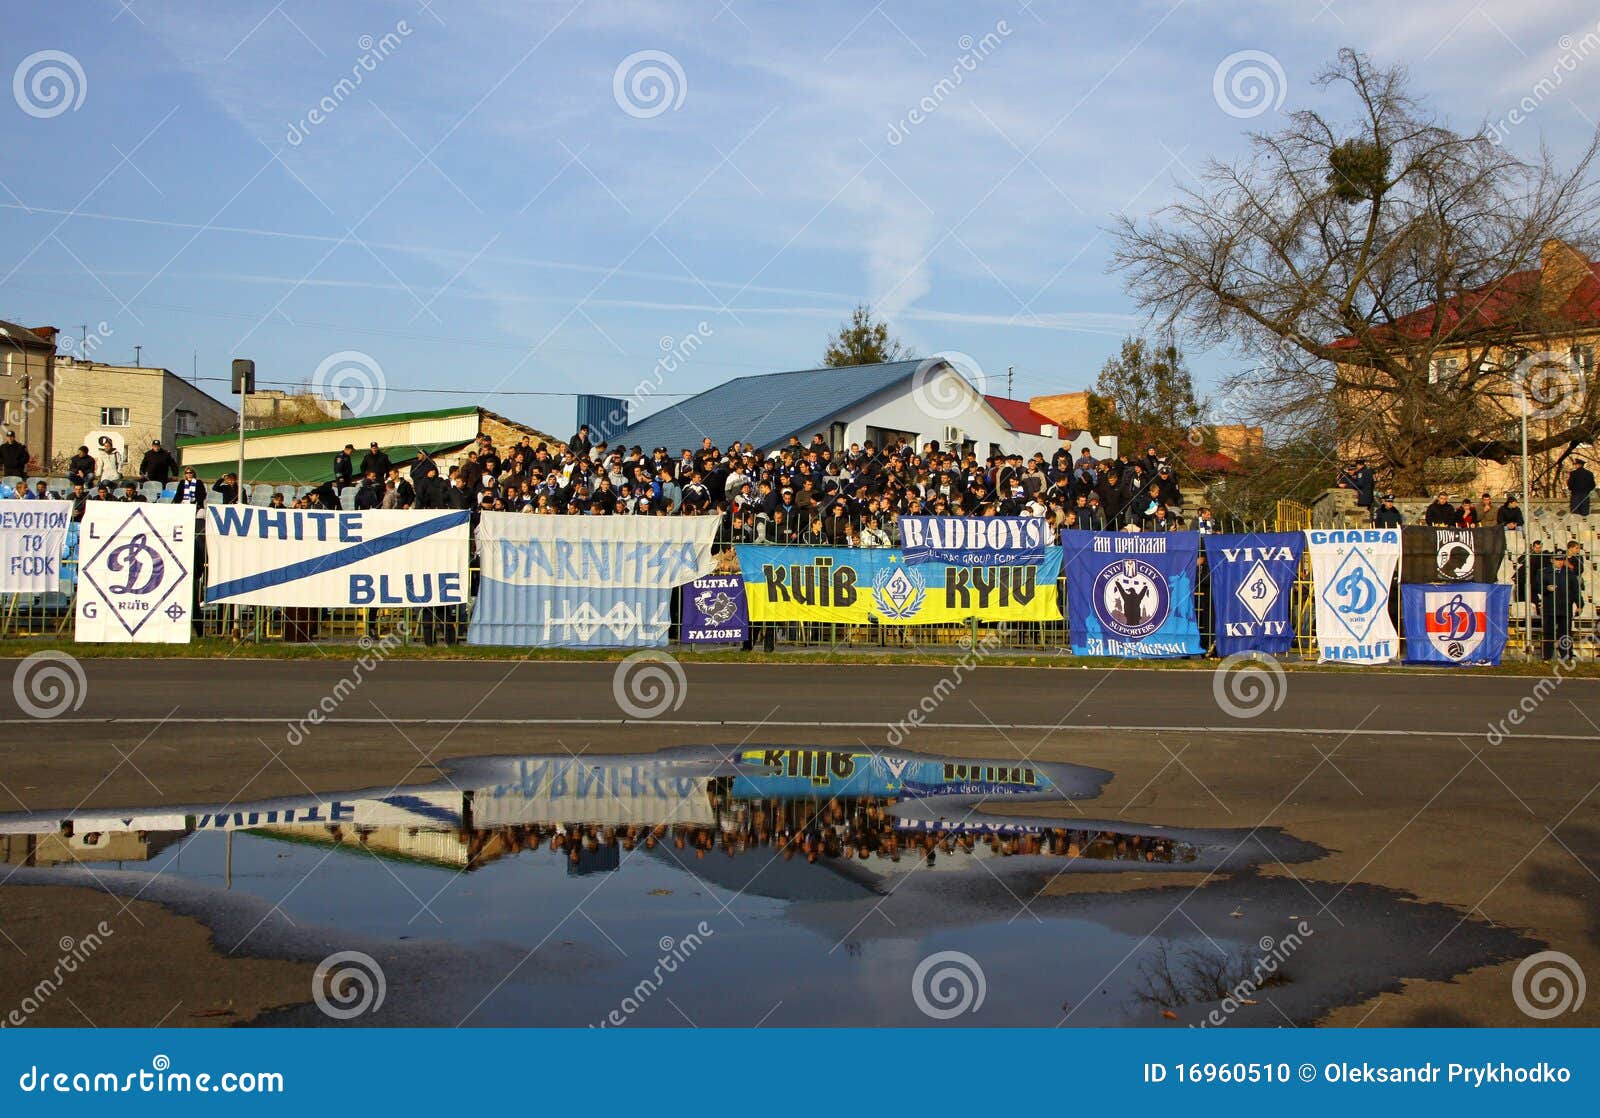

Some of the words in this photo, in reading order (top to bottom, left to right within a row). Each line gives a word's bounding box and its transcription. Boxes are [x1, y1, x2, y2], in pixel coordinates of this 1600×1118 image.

[208, 506, 363, 542] WHITE
[901, 518, 1041, 549] BADBOYS
[23, 534, 42, 551] TO
[1310, 531, 1398, 544] СЛАВА
[500, 537, 698, 583] DARNITSA
[1221, 547, 1294, 562] VIVA
[11, 556, 55, 576] FCDK
[1139, 565, 1159, 580] CITY
[349, 573, 461, 604] BLUE
[945, 565, 1037, 609] KYIV
[688, 629, 741, 639] FAZIONE
